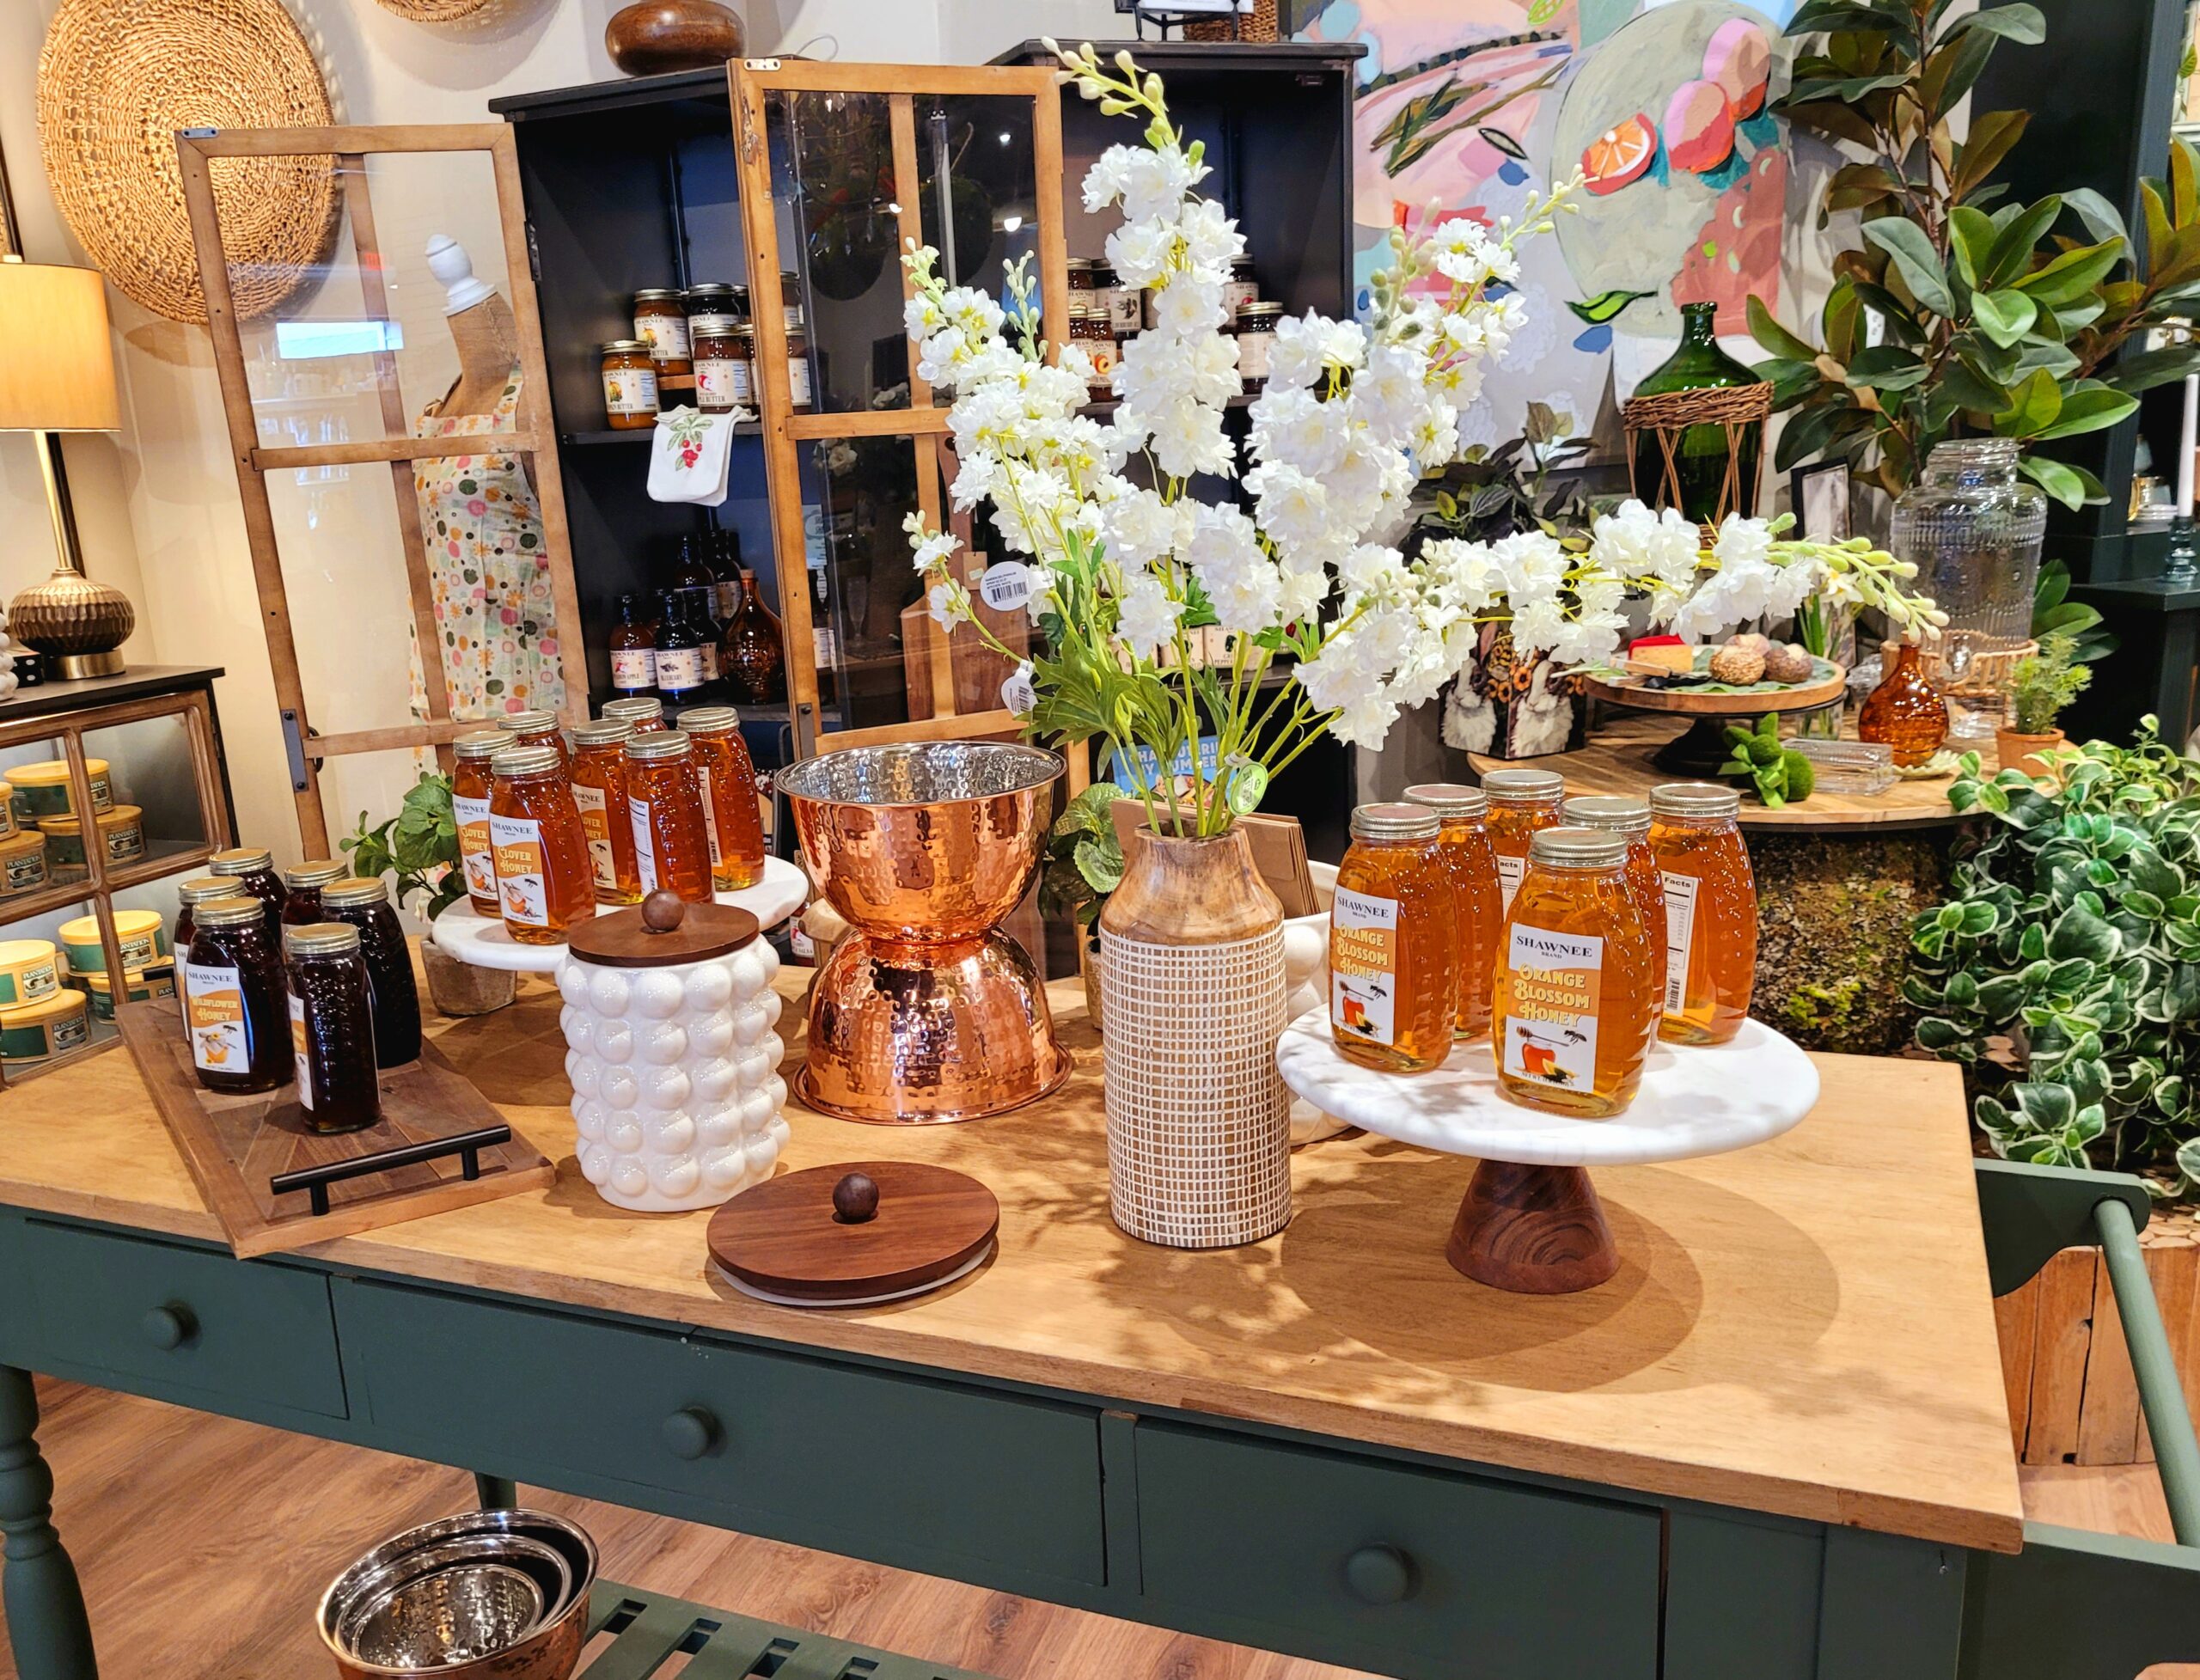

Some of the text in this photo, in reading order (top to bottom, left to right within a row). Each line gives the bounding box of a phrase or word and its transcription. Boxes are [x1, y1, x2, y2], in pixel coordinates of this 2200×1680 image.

[461, 825, 488, 840] CLOVER
[492, 821, 533, 834] SHAWNEE
[463, 837, 488, 852] HONEY
[498, 846, 532, 862] CLOVER
[500, 859, 533, 875] HONEY
[1664, 877, 1691, 889] Facts
[1337, 896, 1390, 918] SHAWNEE
[120, 938, 150, 950] ANTATION
[1339, 924, 1384, 948] ORANGE
[1336, 937, 1389, 967] BLOSSOM
[1516, 935, 1593, 957] SHAWNEE
[1541, 950, 1562, 959] BRAND
[188, 971, 233, 982] SHAWNEE
[1340, 956, 1383, 984] HONEY
[1519, 962, 1586, 989] ORANGE
[1513, 979, 1591, 1010] BLOSSOM
[192, 997, 239, 1009] WILDFLOWER
[197, 1007, 231, 1021] HONEY
[1519, 1001, 1582, 1028] HONEY
